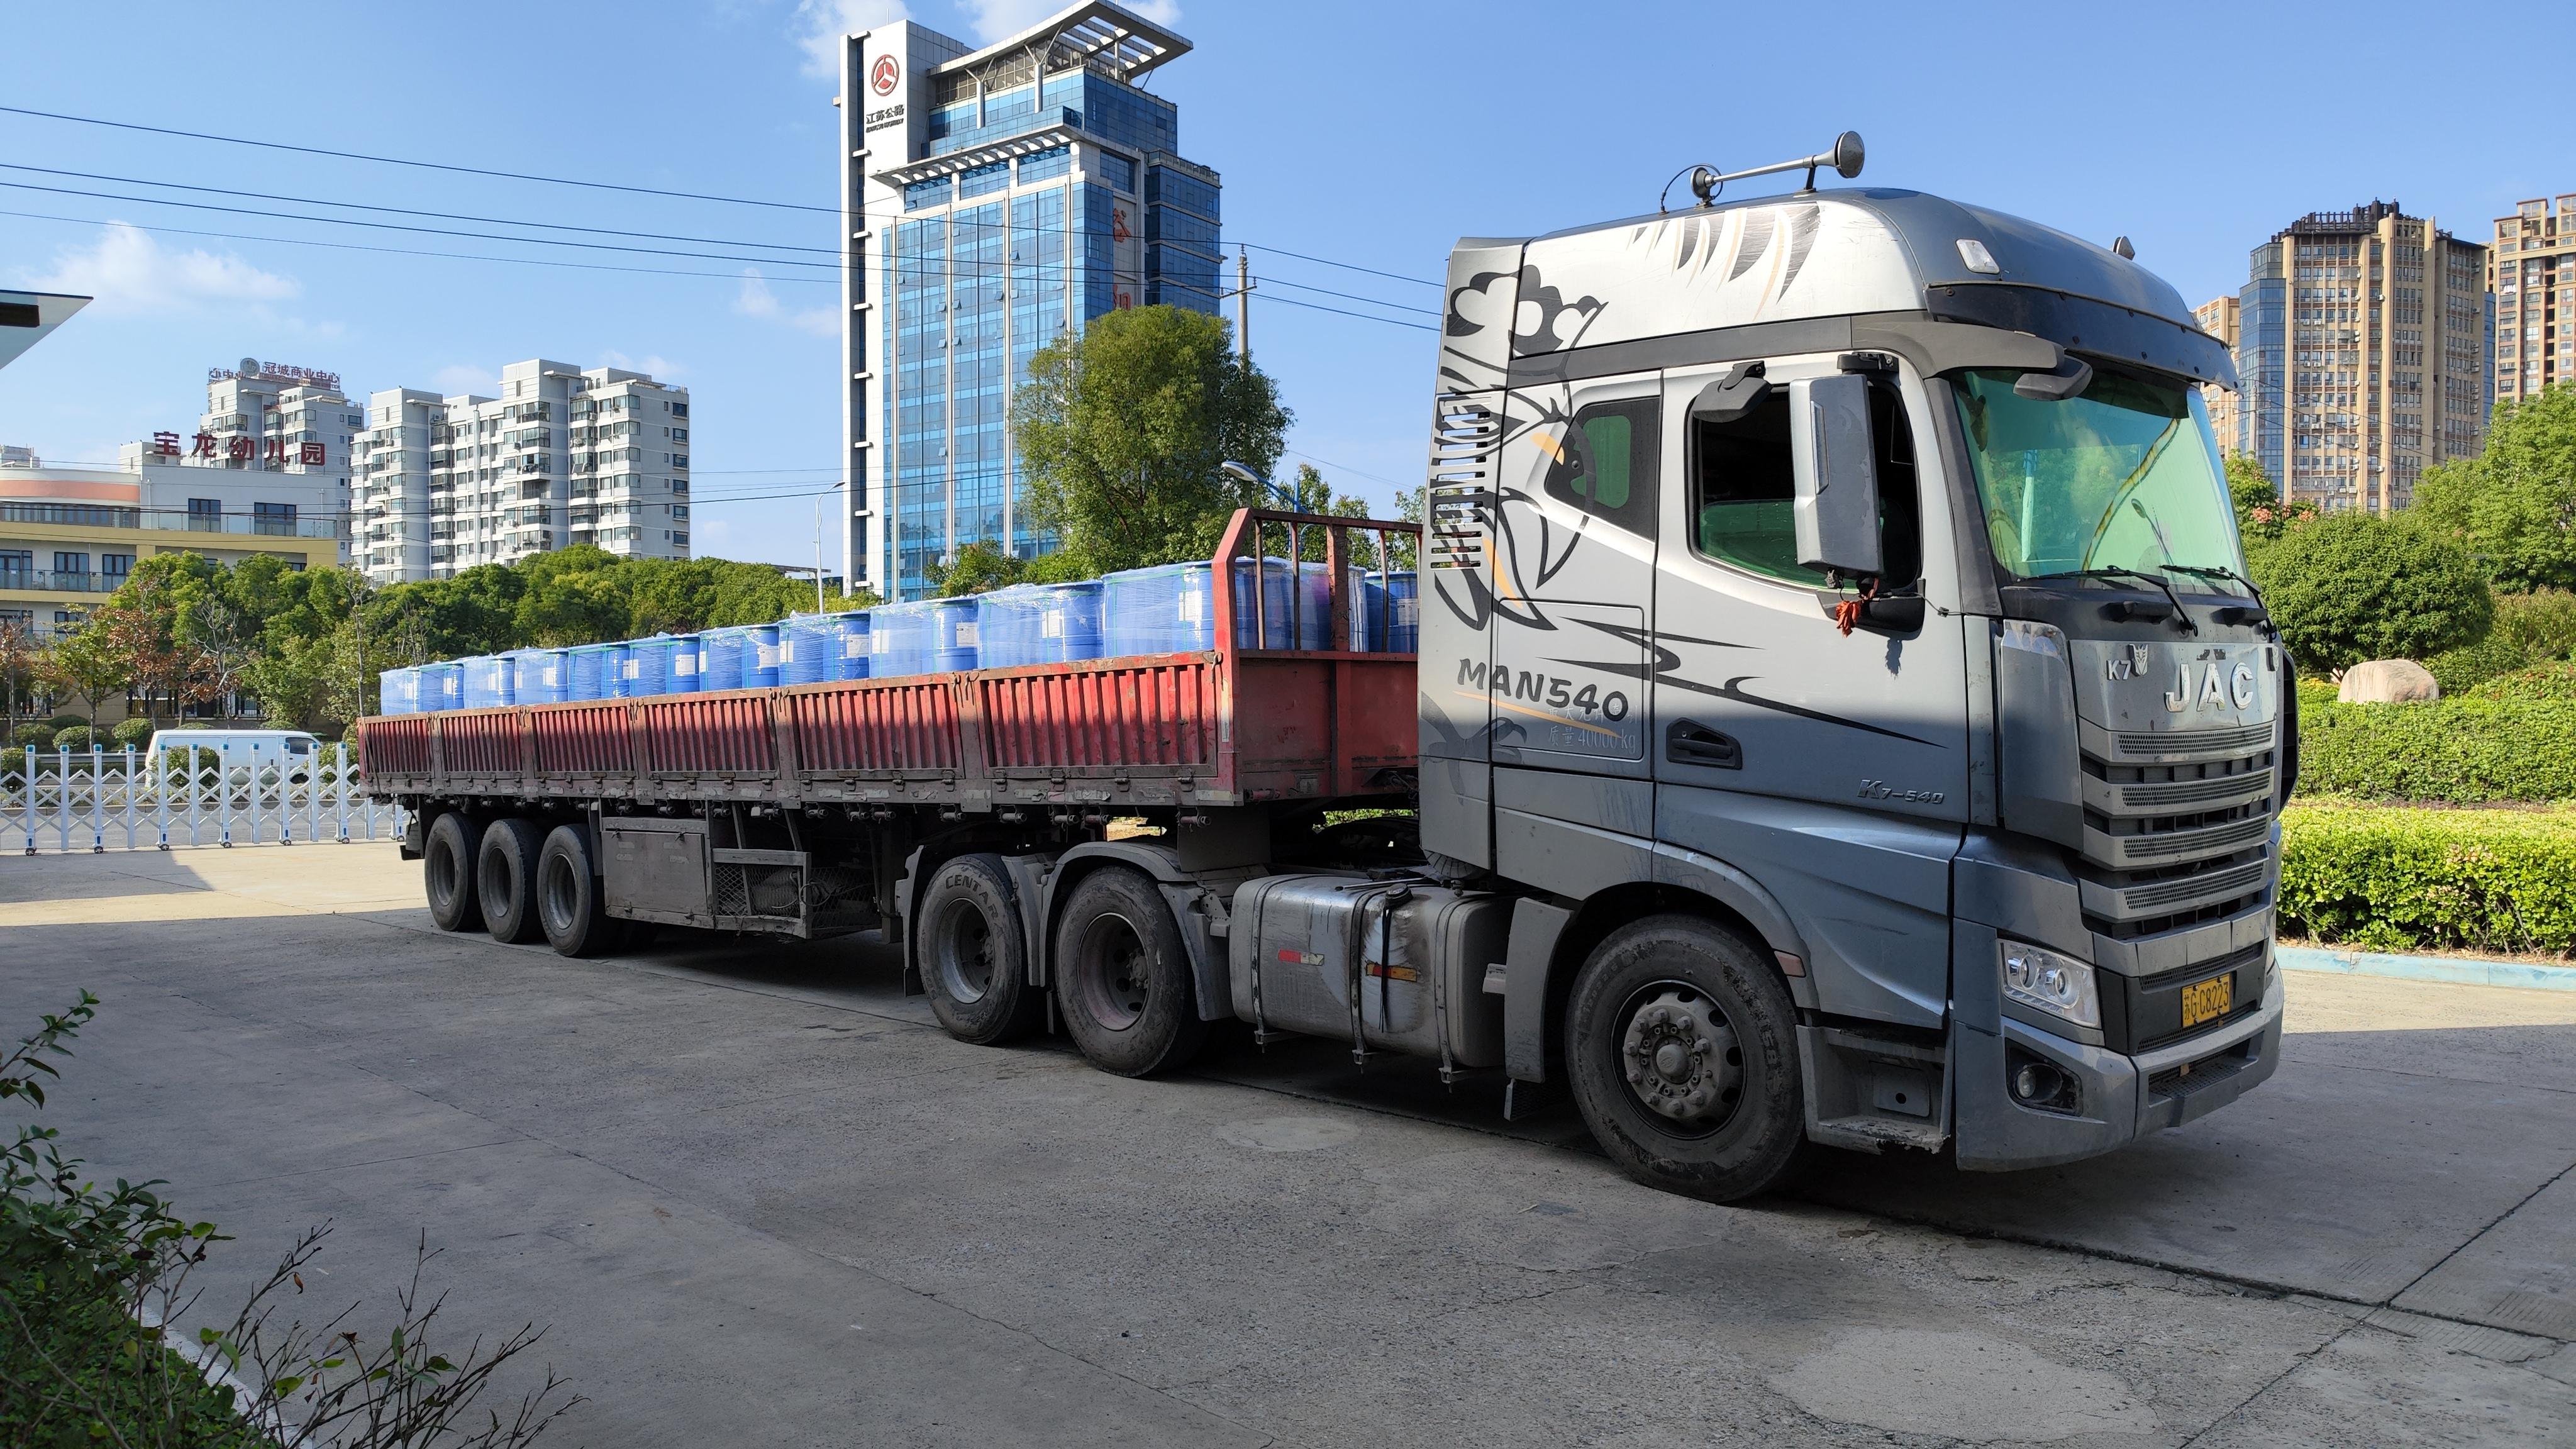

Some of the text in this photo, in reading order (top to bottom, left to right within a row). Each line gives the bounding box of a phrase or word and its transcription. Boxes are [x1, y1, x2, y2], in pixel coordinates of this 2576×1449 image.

[866, 104, 904, 124] 江苏公路
[264, 362, 340, 384] 冠城商业中心
[153, 431, 325, 465] 宝龙幼儿园
[2106, 660, 2131, 680] K7
[1457, 658, 1628, 721] MAN540
[2163, 662, 2253, 713] JAC
[1857, 779, 1945, 804] K7-540
[945, 874, 1006, 939] CENTARA
